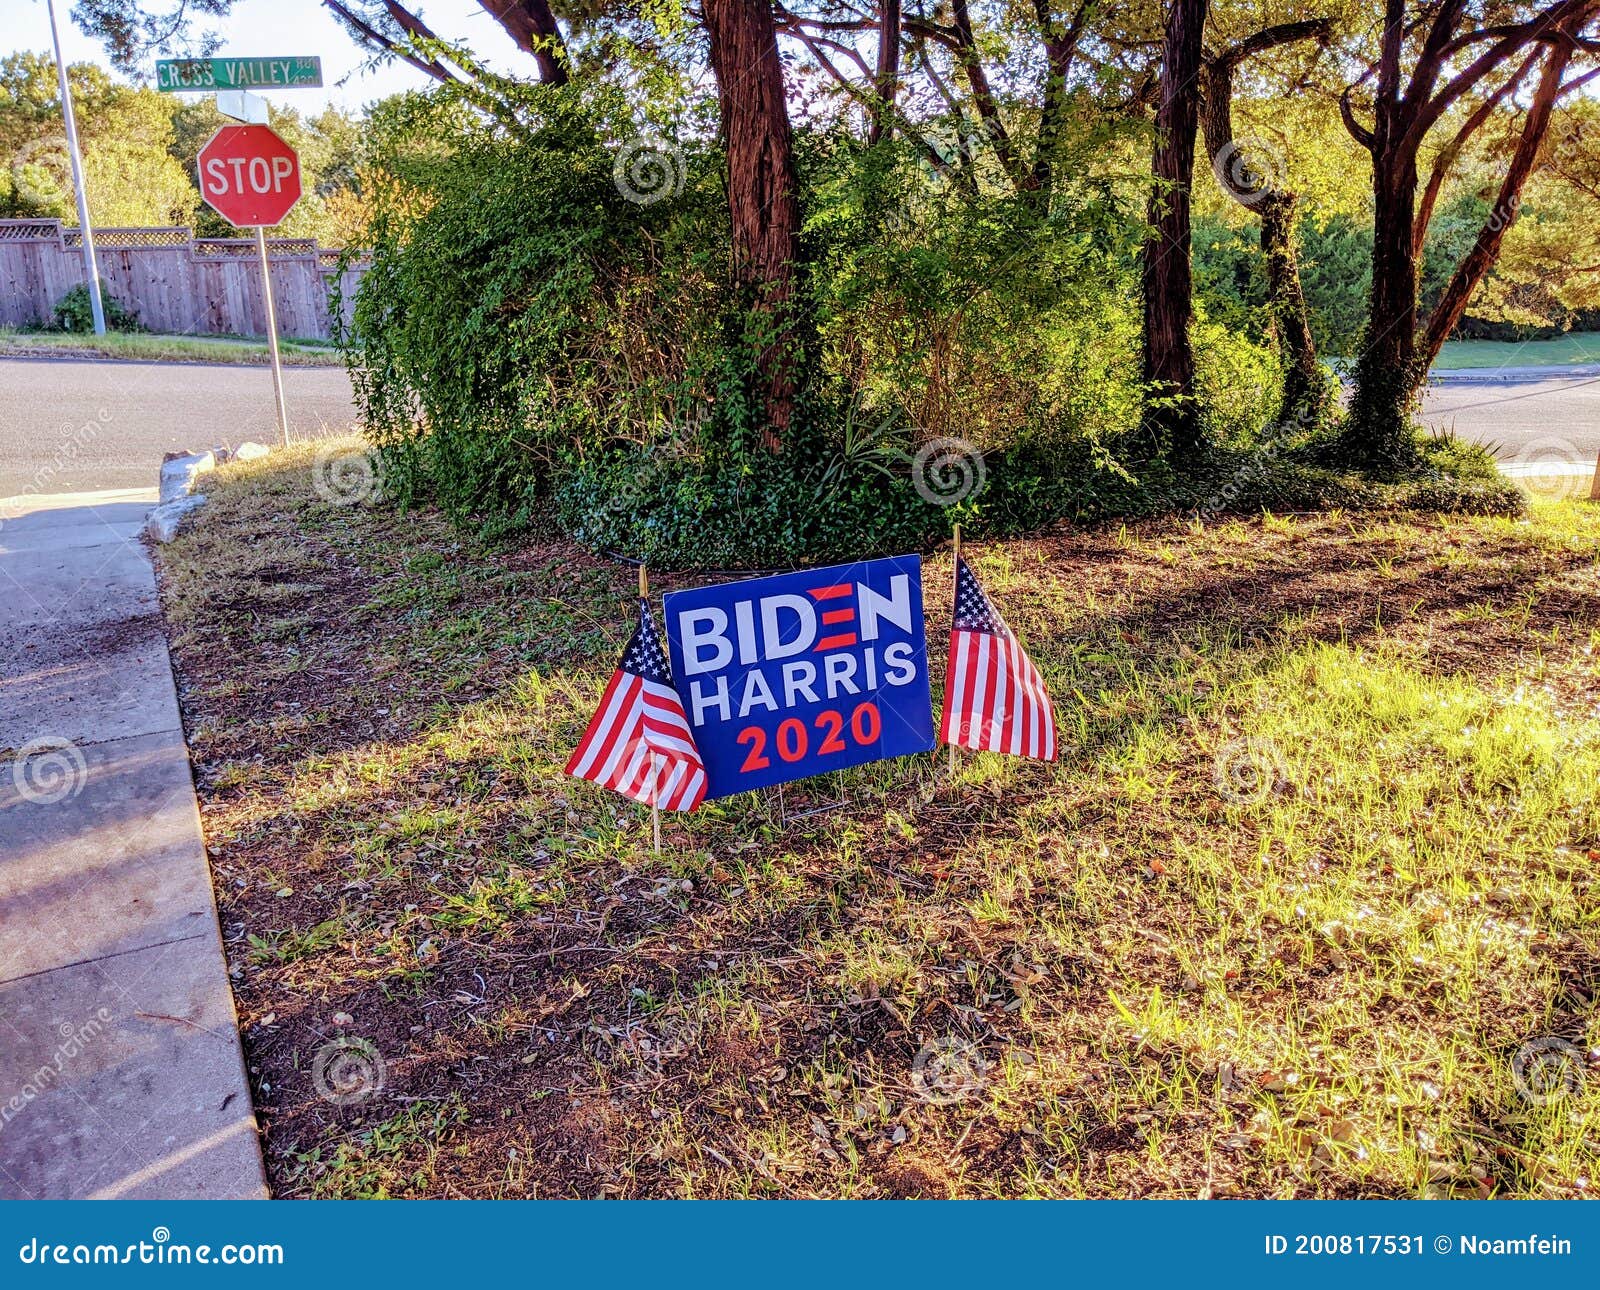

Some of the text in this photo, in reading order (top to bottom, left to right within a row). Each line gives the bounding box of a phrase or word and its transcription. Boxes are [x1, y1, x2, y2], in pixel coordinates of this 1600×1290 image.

[158, 61, 291, 87] CROSS VALLEY
[206, 156, 293, 195] STOP
[678, 573, 912, 677] BIDEN
[689, 642, 917, 727] HARRIS
[736, 702, 882, 773] 2020
